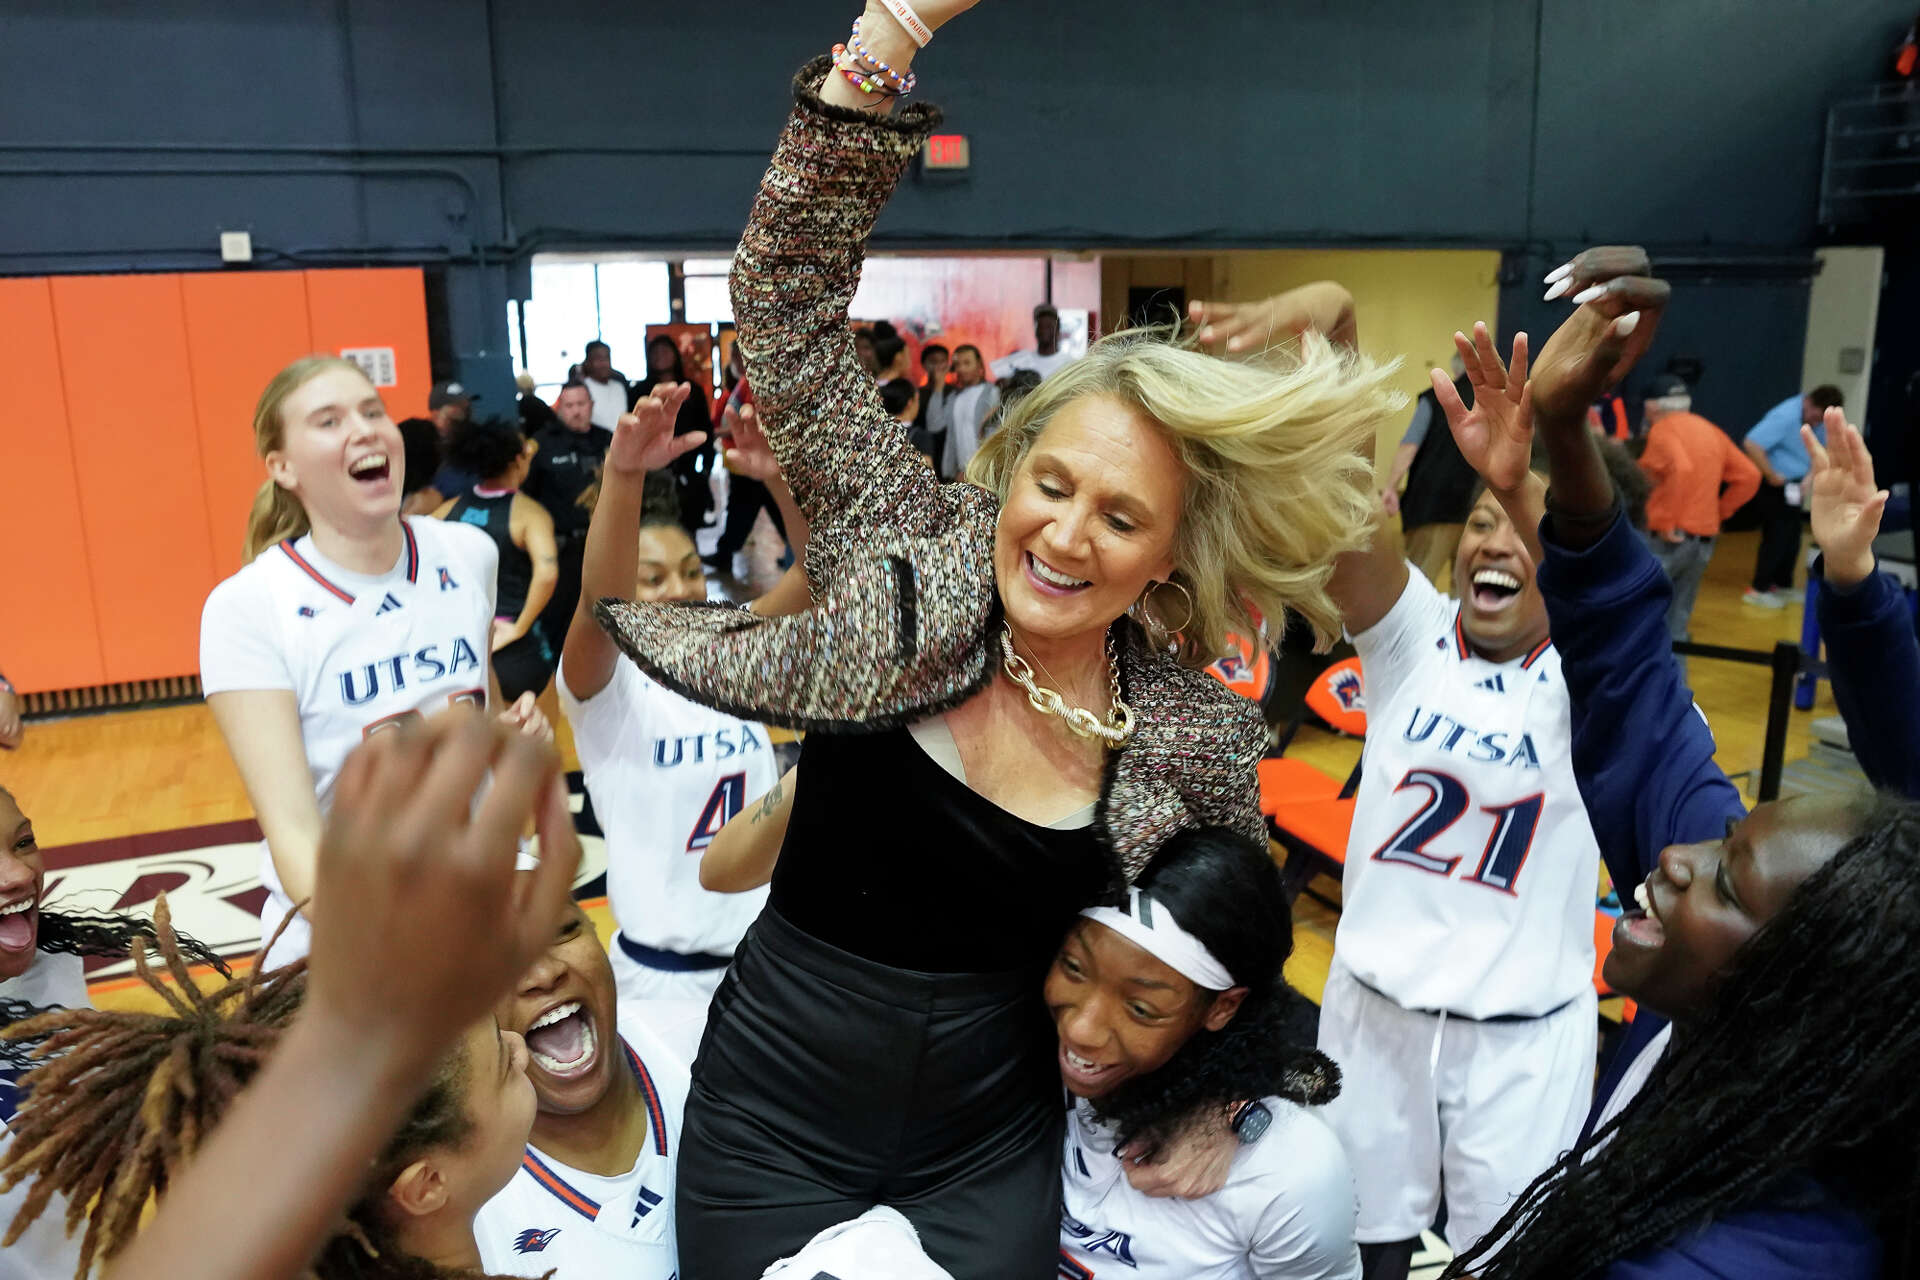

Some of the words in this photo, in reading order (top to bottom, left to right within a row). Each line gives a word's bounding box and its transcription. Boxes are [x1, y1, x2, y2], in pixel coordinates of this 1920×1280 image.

[339, 637, 480, 706] UTSA
[653, 724, 762, 768] UTSA
[1402, 705, 1541, 769] UTSA
[686, 771, 746, 854] 4
[1370, 767, 1545, 899] 21
